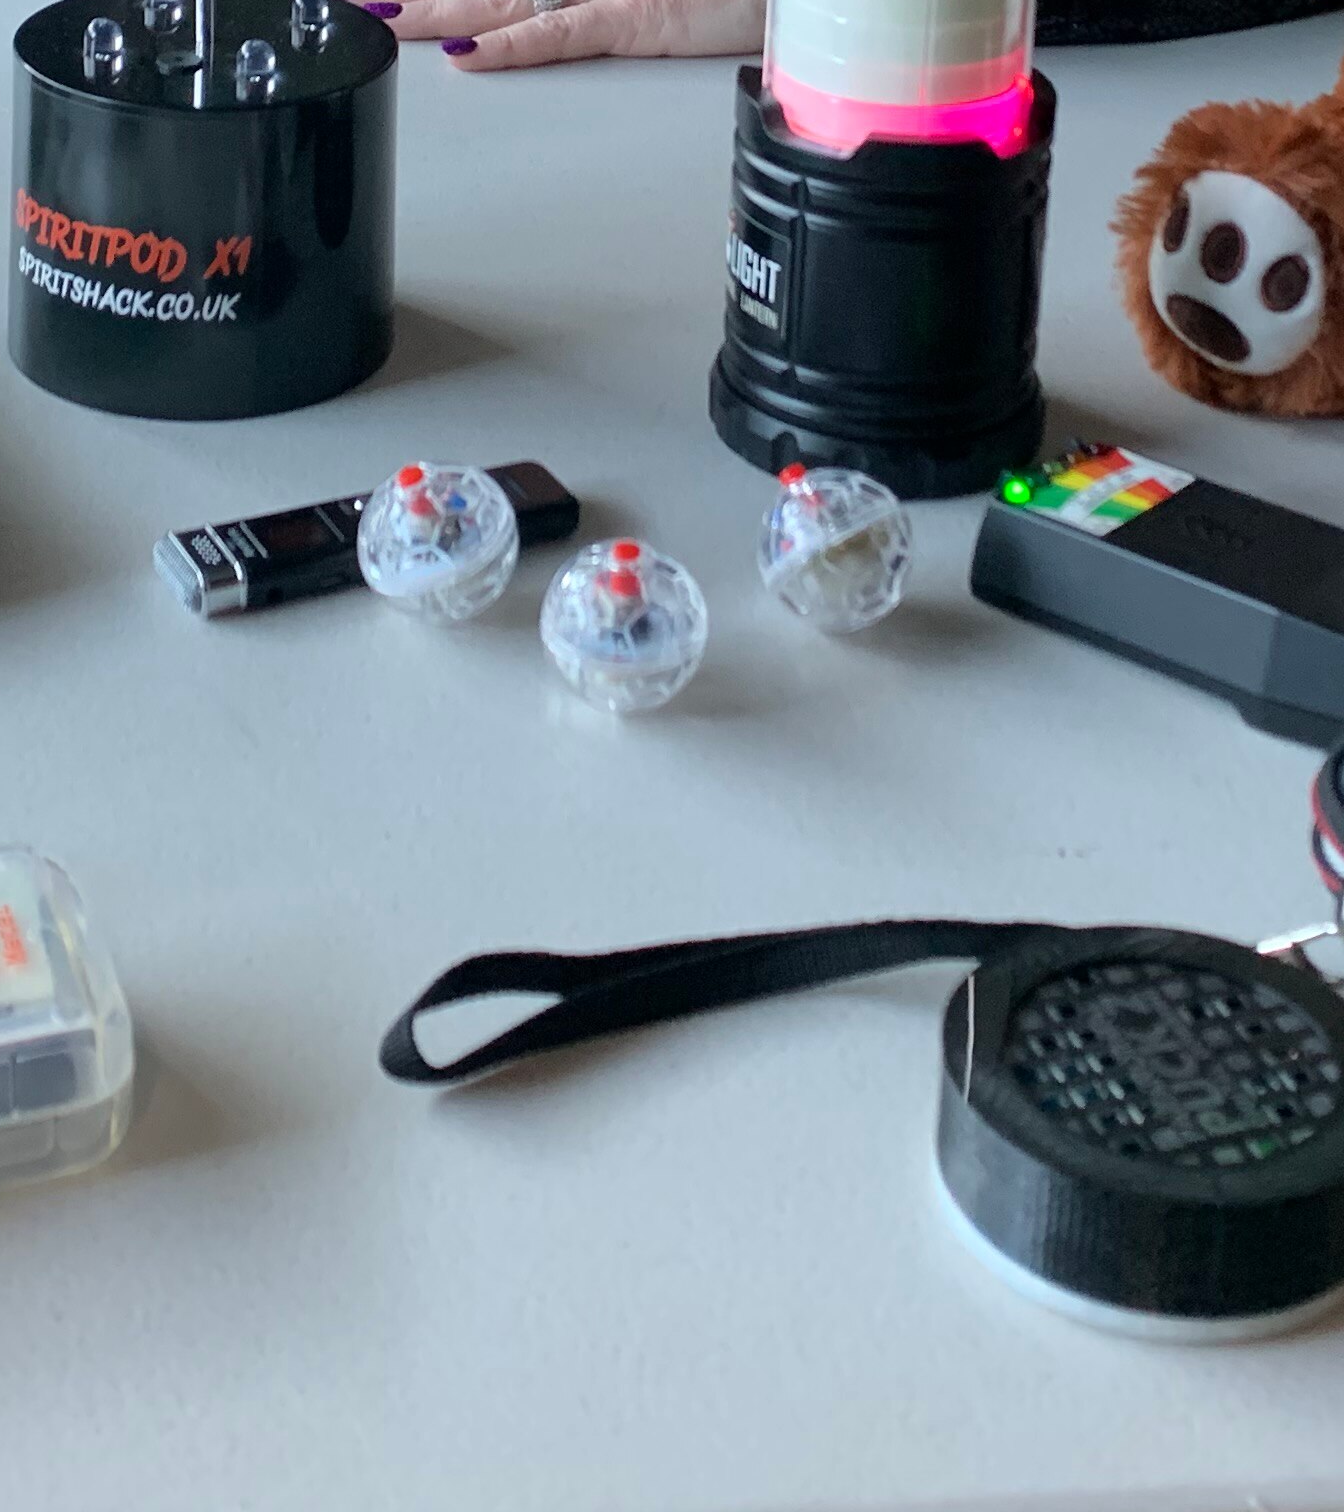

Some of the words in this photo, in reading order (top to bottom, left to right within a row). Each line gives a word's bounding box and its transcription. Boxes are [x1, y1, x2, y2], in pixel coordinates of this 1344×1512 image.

[16, 188, 187, 283] SPIRITPOD
[204, 236, 253, 279] X1
[726, 231, 782, 304] LIGHT
[18, 246, 242, 322] SPIRITSHACK.CO.UK
